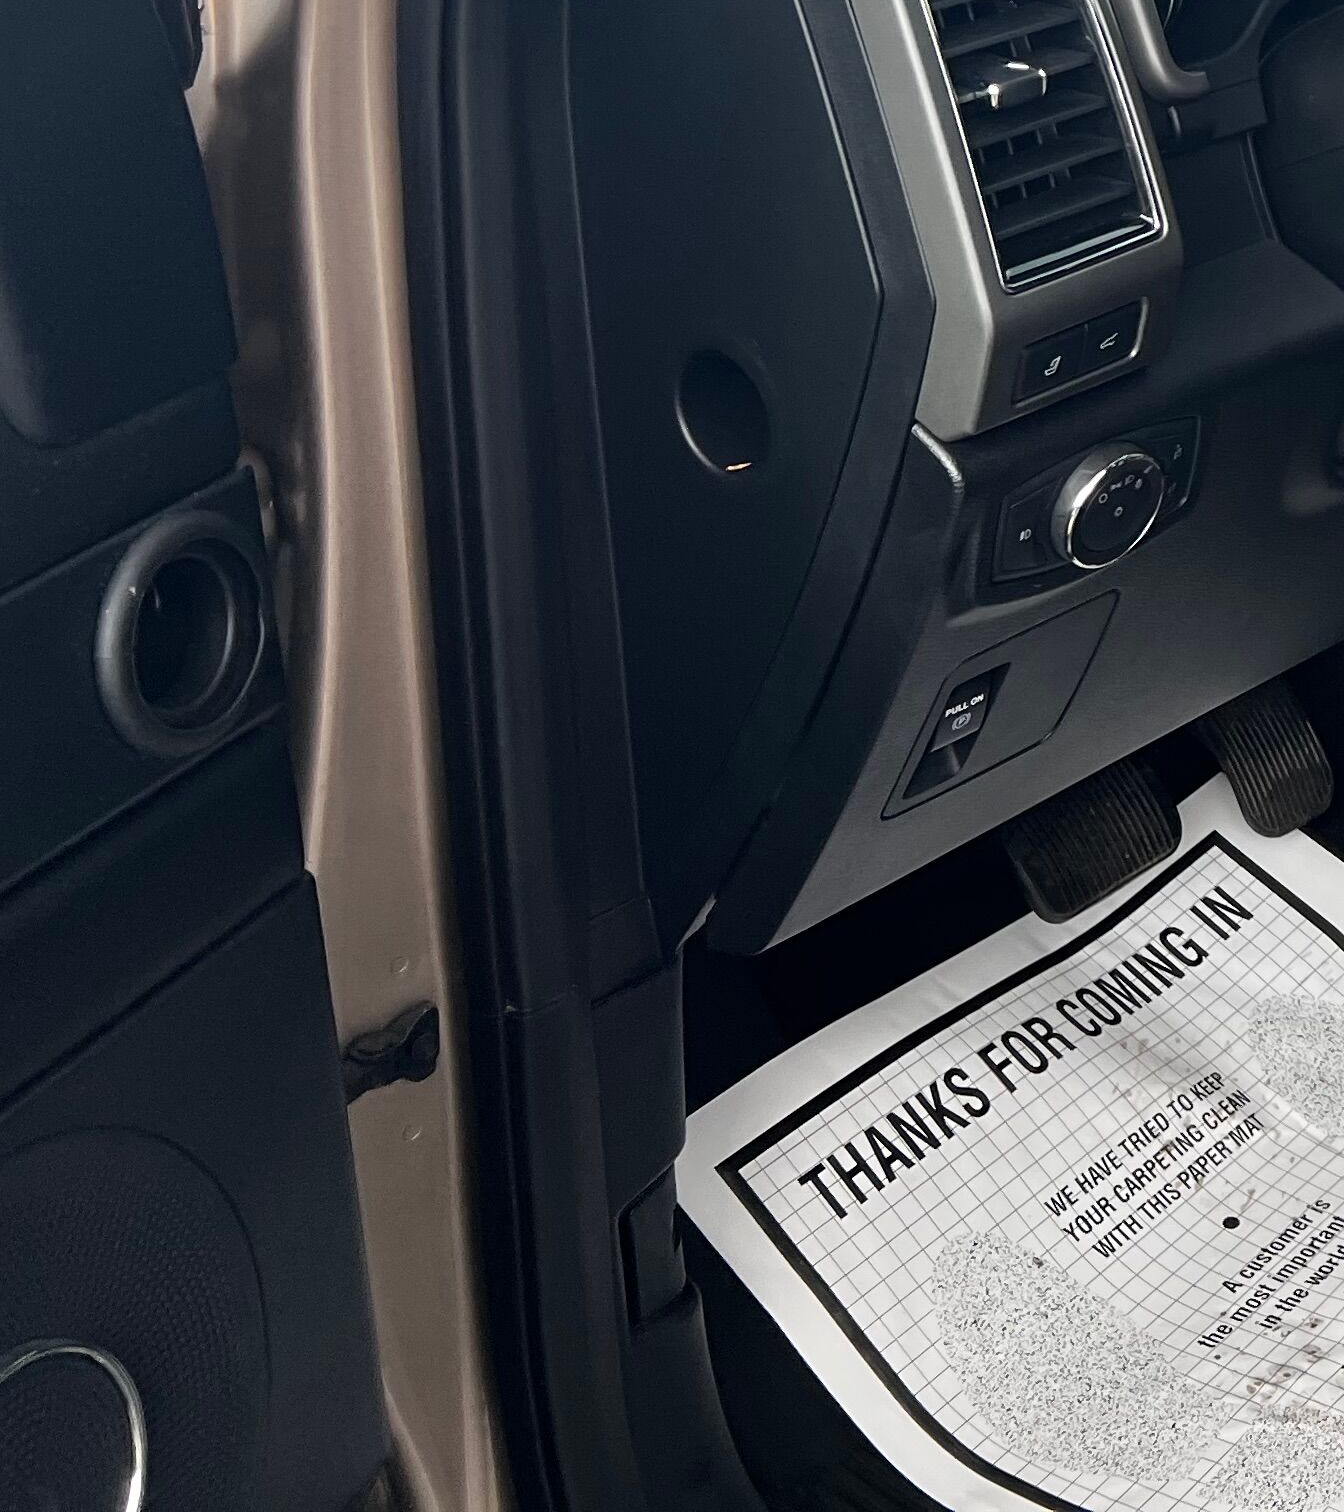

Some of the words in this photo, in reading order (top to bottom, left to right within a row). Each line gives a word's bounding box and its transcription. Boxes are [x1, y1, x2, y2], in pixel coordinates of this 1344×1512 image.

[945, 701, 969, 718] PULL
[970, 693, 985, 706] ON
[798, 1067, 991, 1219] THANKS
[976, 1017, 1077, 1094] FOR
[1055, 926, 1209, 1037] COMING
[1190, 885, 1254, 940] IN
[1044, 1184, 1080, 1217] WE
[1074, 1149, 1124, 1195] HAVE
[1118, 1112, 1171, 1158] TRIED
[1166, 1093, 1194, 1120] TO
[1189, 1071, 1226, 1102] KEEP
[1063, 1196, 1117, 1242] YOUR
[1113, 1123, 1205, 1203] CARPETING
[1202, 1089, 1251, 1130] CLEAN
[1091, 1214, 1144, 1258] WITH
[1137, 1183, 1181, 1220] THIS
[1176, 1140, 1234, 1189] PAPER
[1228, 1113, 1265, 1148] MAT
[1221, 1279, 1243, 1294] A
[1239, 1212, 1314, 1280] customer
[1306, 1199, 1332, 1214] is
[1197, 1323, 1233, 1348] the
[1229, 1283, 1277, 1322] most
[1254, 1314, 1283, 1330] in
[1274, 1287, 1310, 1313] the
